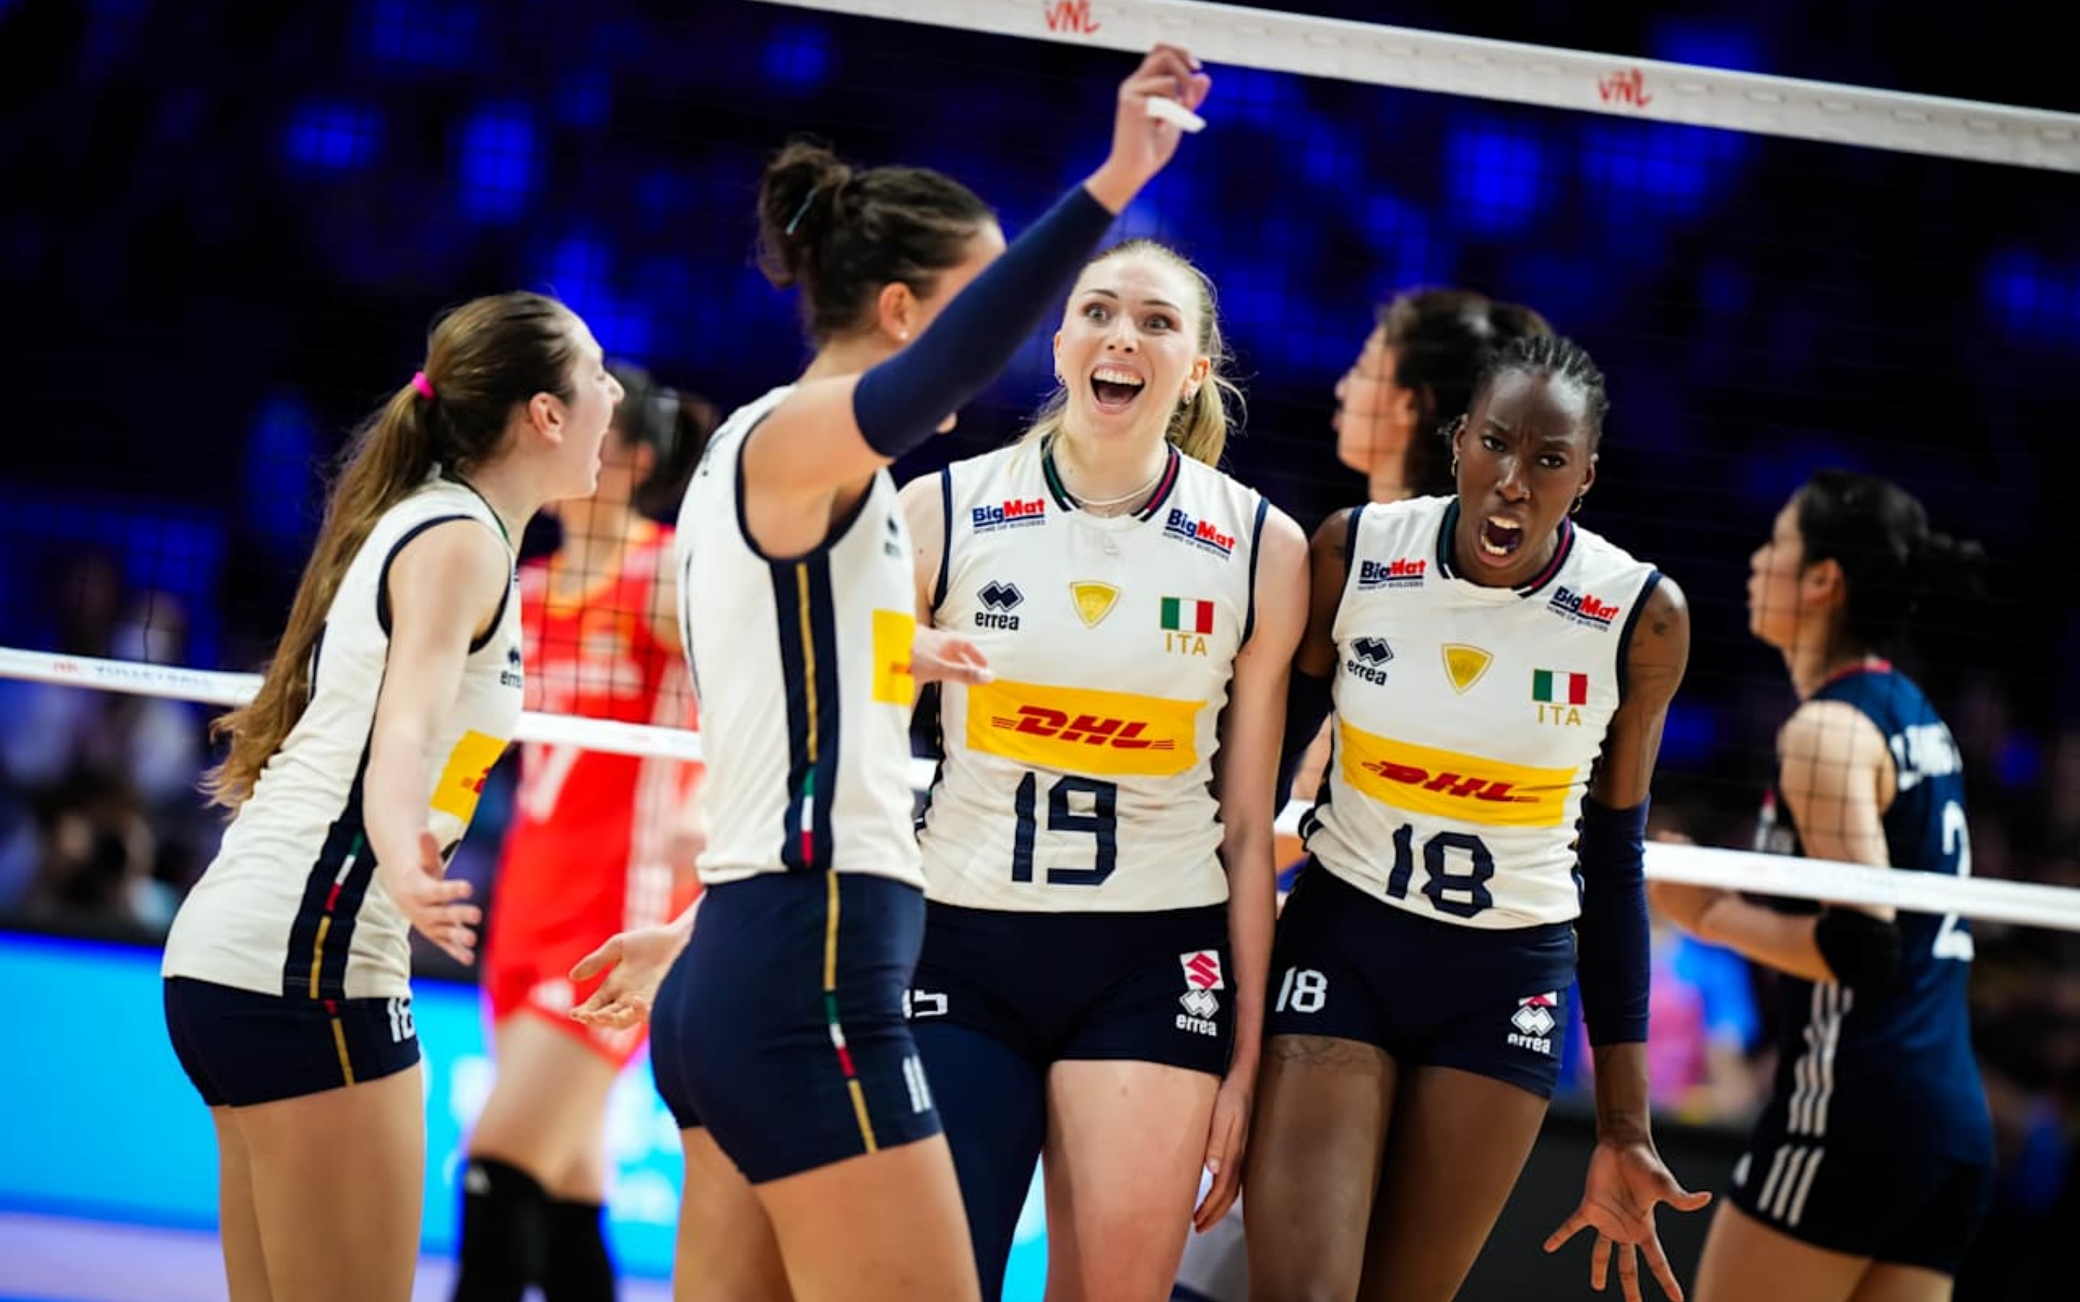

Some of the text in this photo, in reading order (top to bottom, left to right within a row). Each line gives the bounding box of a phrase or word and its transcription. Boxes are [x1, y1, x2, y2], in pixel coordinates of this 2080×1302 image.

[973, 497, 1045, 523] BigMat
[1167, 508, 1235, 550] BigMat
[1361, 557, 1426, 580] BigMat
[1553, 585, 1619, 620] BigMat
[974, 611, 1019, 631] errea
[1165, 633, 1208, 656] ITA
[1347, 659, 1387, 686] errea
[1014, 705, 1154, 749] DHL
[1538, 705, 1582, 726] ITA
[1377, 760, 1516, 803] DHL
[1011, 771, 1118, 887] 19
[1385, 823, 1495, 919] 18
[1275, 966, 1328, 1013] 18
[1176, 1014, 1218, 1036] errea
